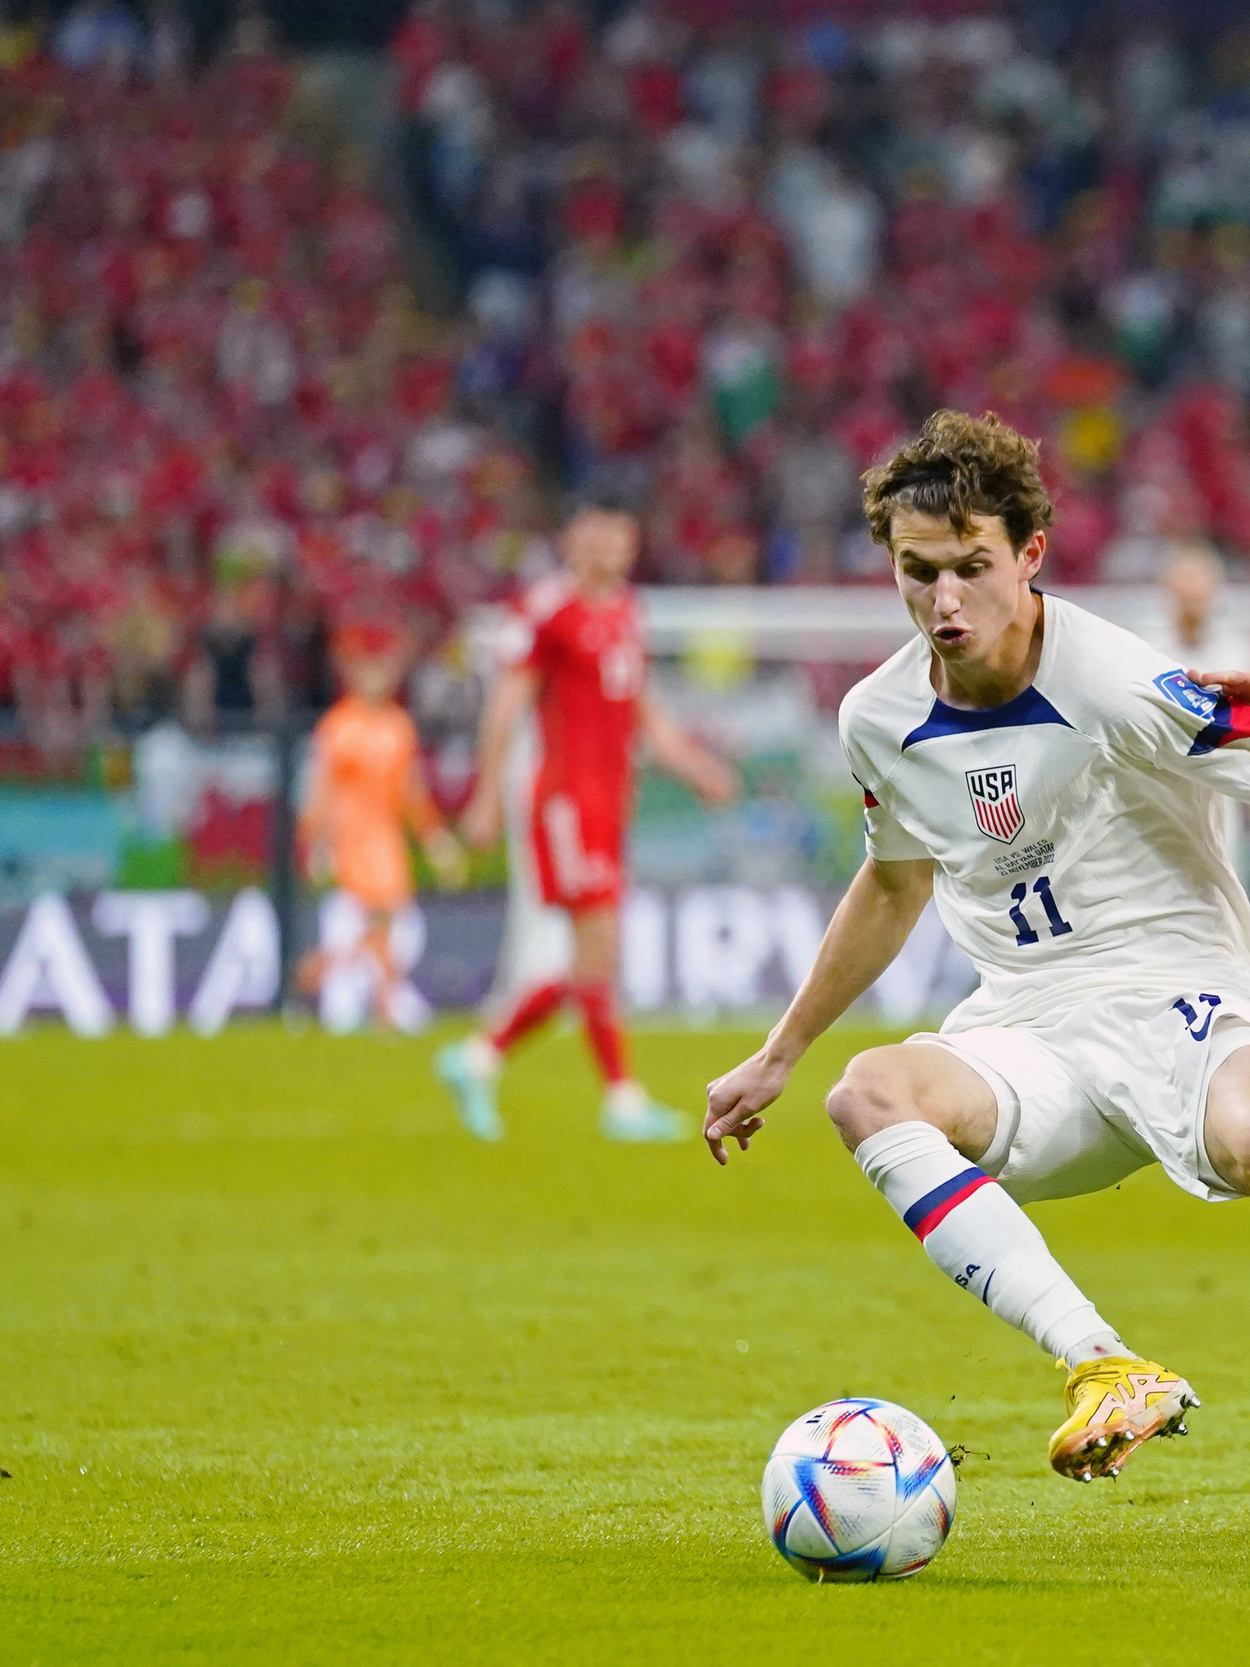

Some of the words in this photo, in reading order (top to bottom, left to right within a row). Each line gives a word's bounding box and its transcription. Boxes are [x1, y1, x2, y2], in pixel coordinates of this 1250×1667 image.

[970, 770, 1013, 802] USA
[994, 855, 1010, 864] USA
[1021, 839, 1048, 854] WALES
[1008, 857, 1043, 874] NOVEMBER
[1009, 876, 1073, 946] 11
